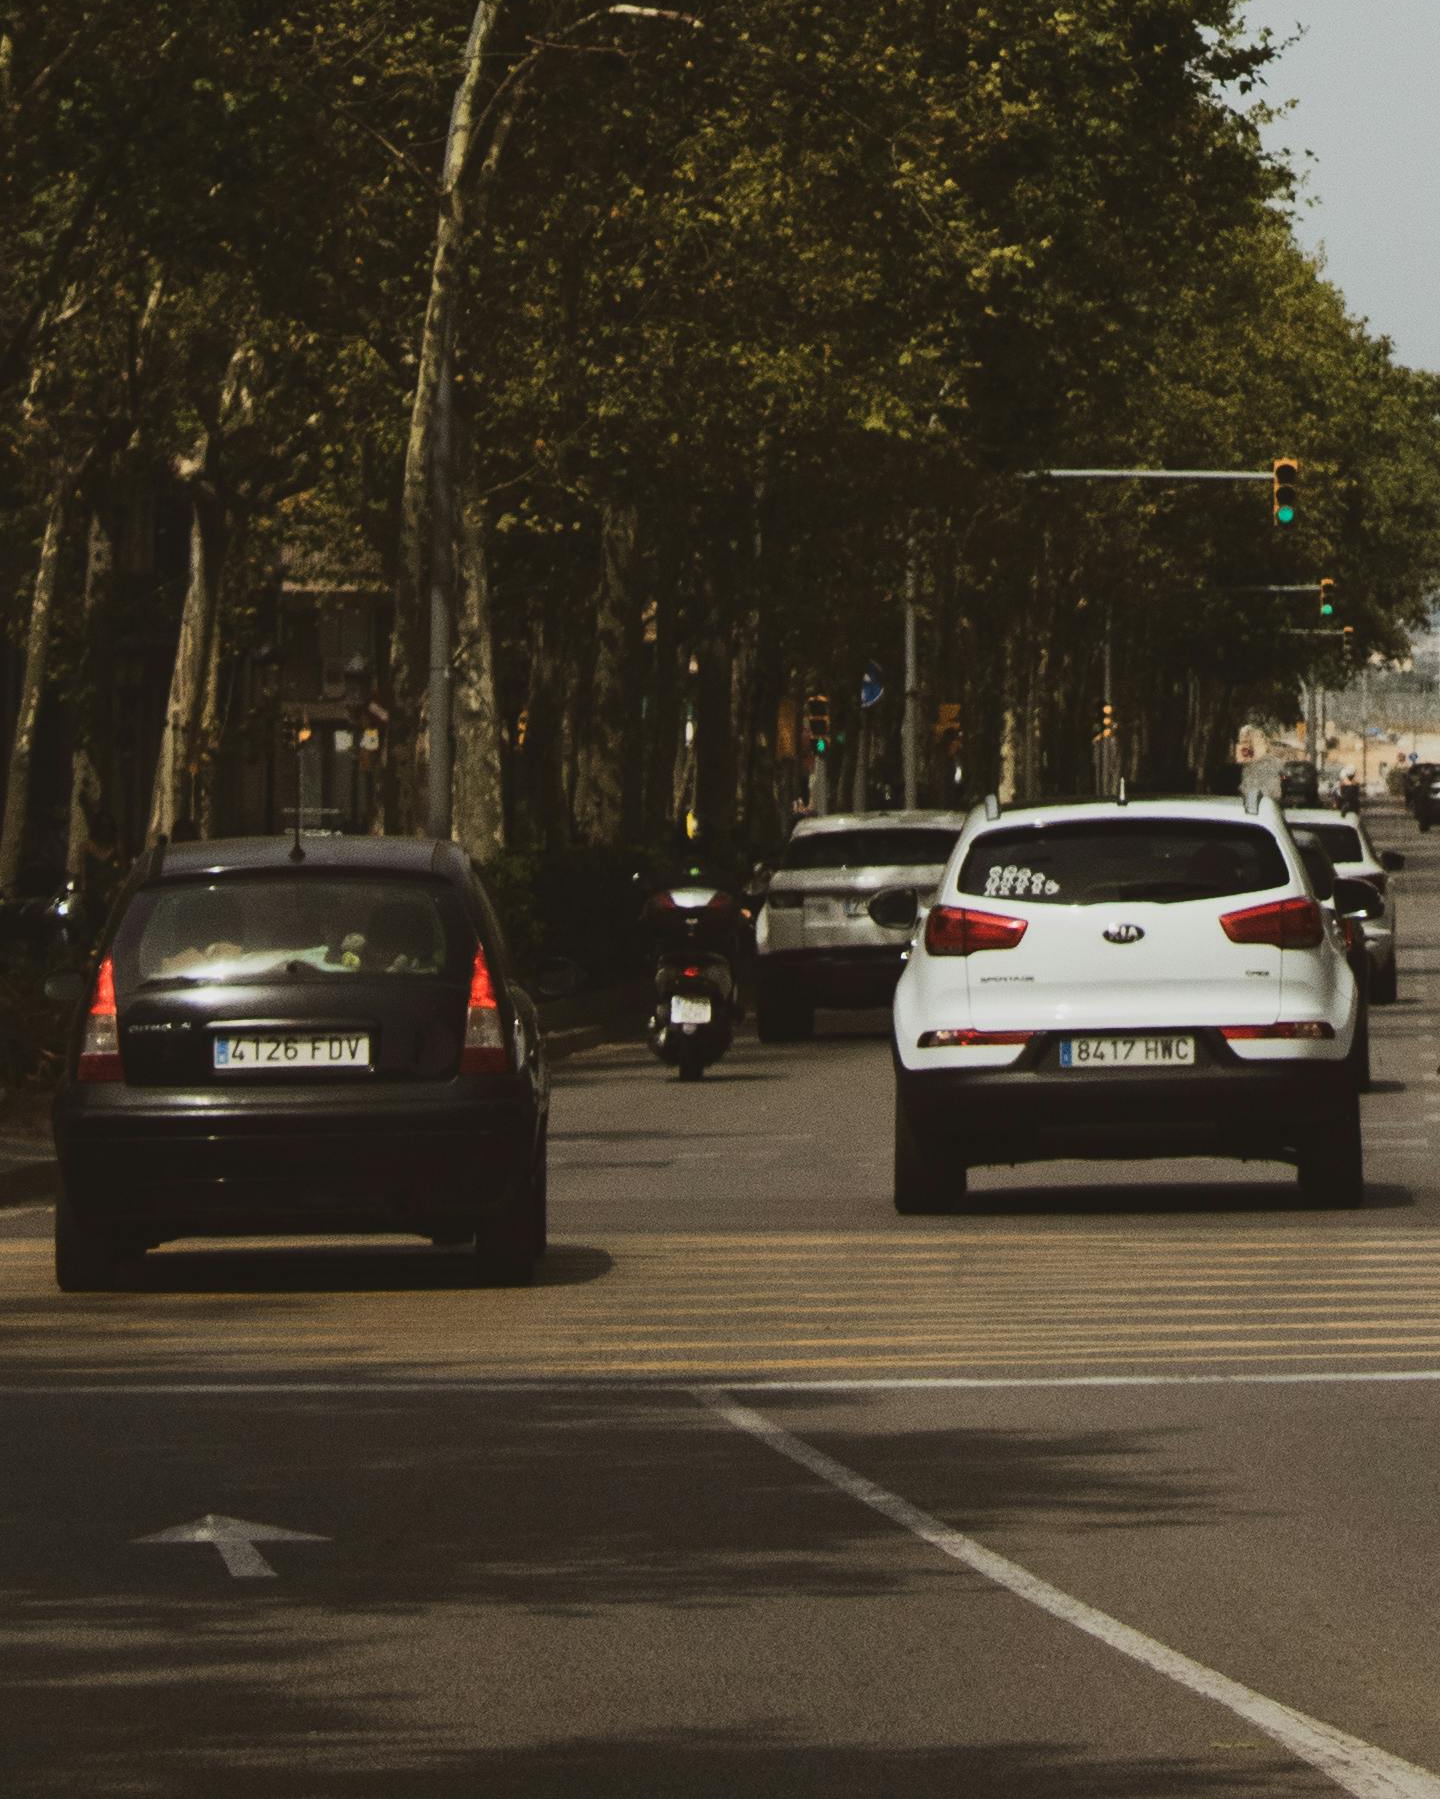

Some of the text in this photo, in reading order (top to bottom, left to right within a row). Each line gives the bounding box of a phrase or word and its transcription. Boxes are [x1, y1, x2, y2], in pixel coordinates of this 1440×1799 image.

[1108, 924, 1139, 941] KIA
[231, 1036, 361, 1061] 4126 FDV
[1078, 1037, 1189, 1061] 8417 HWC
